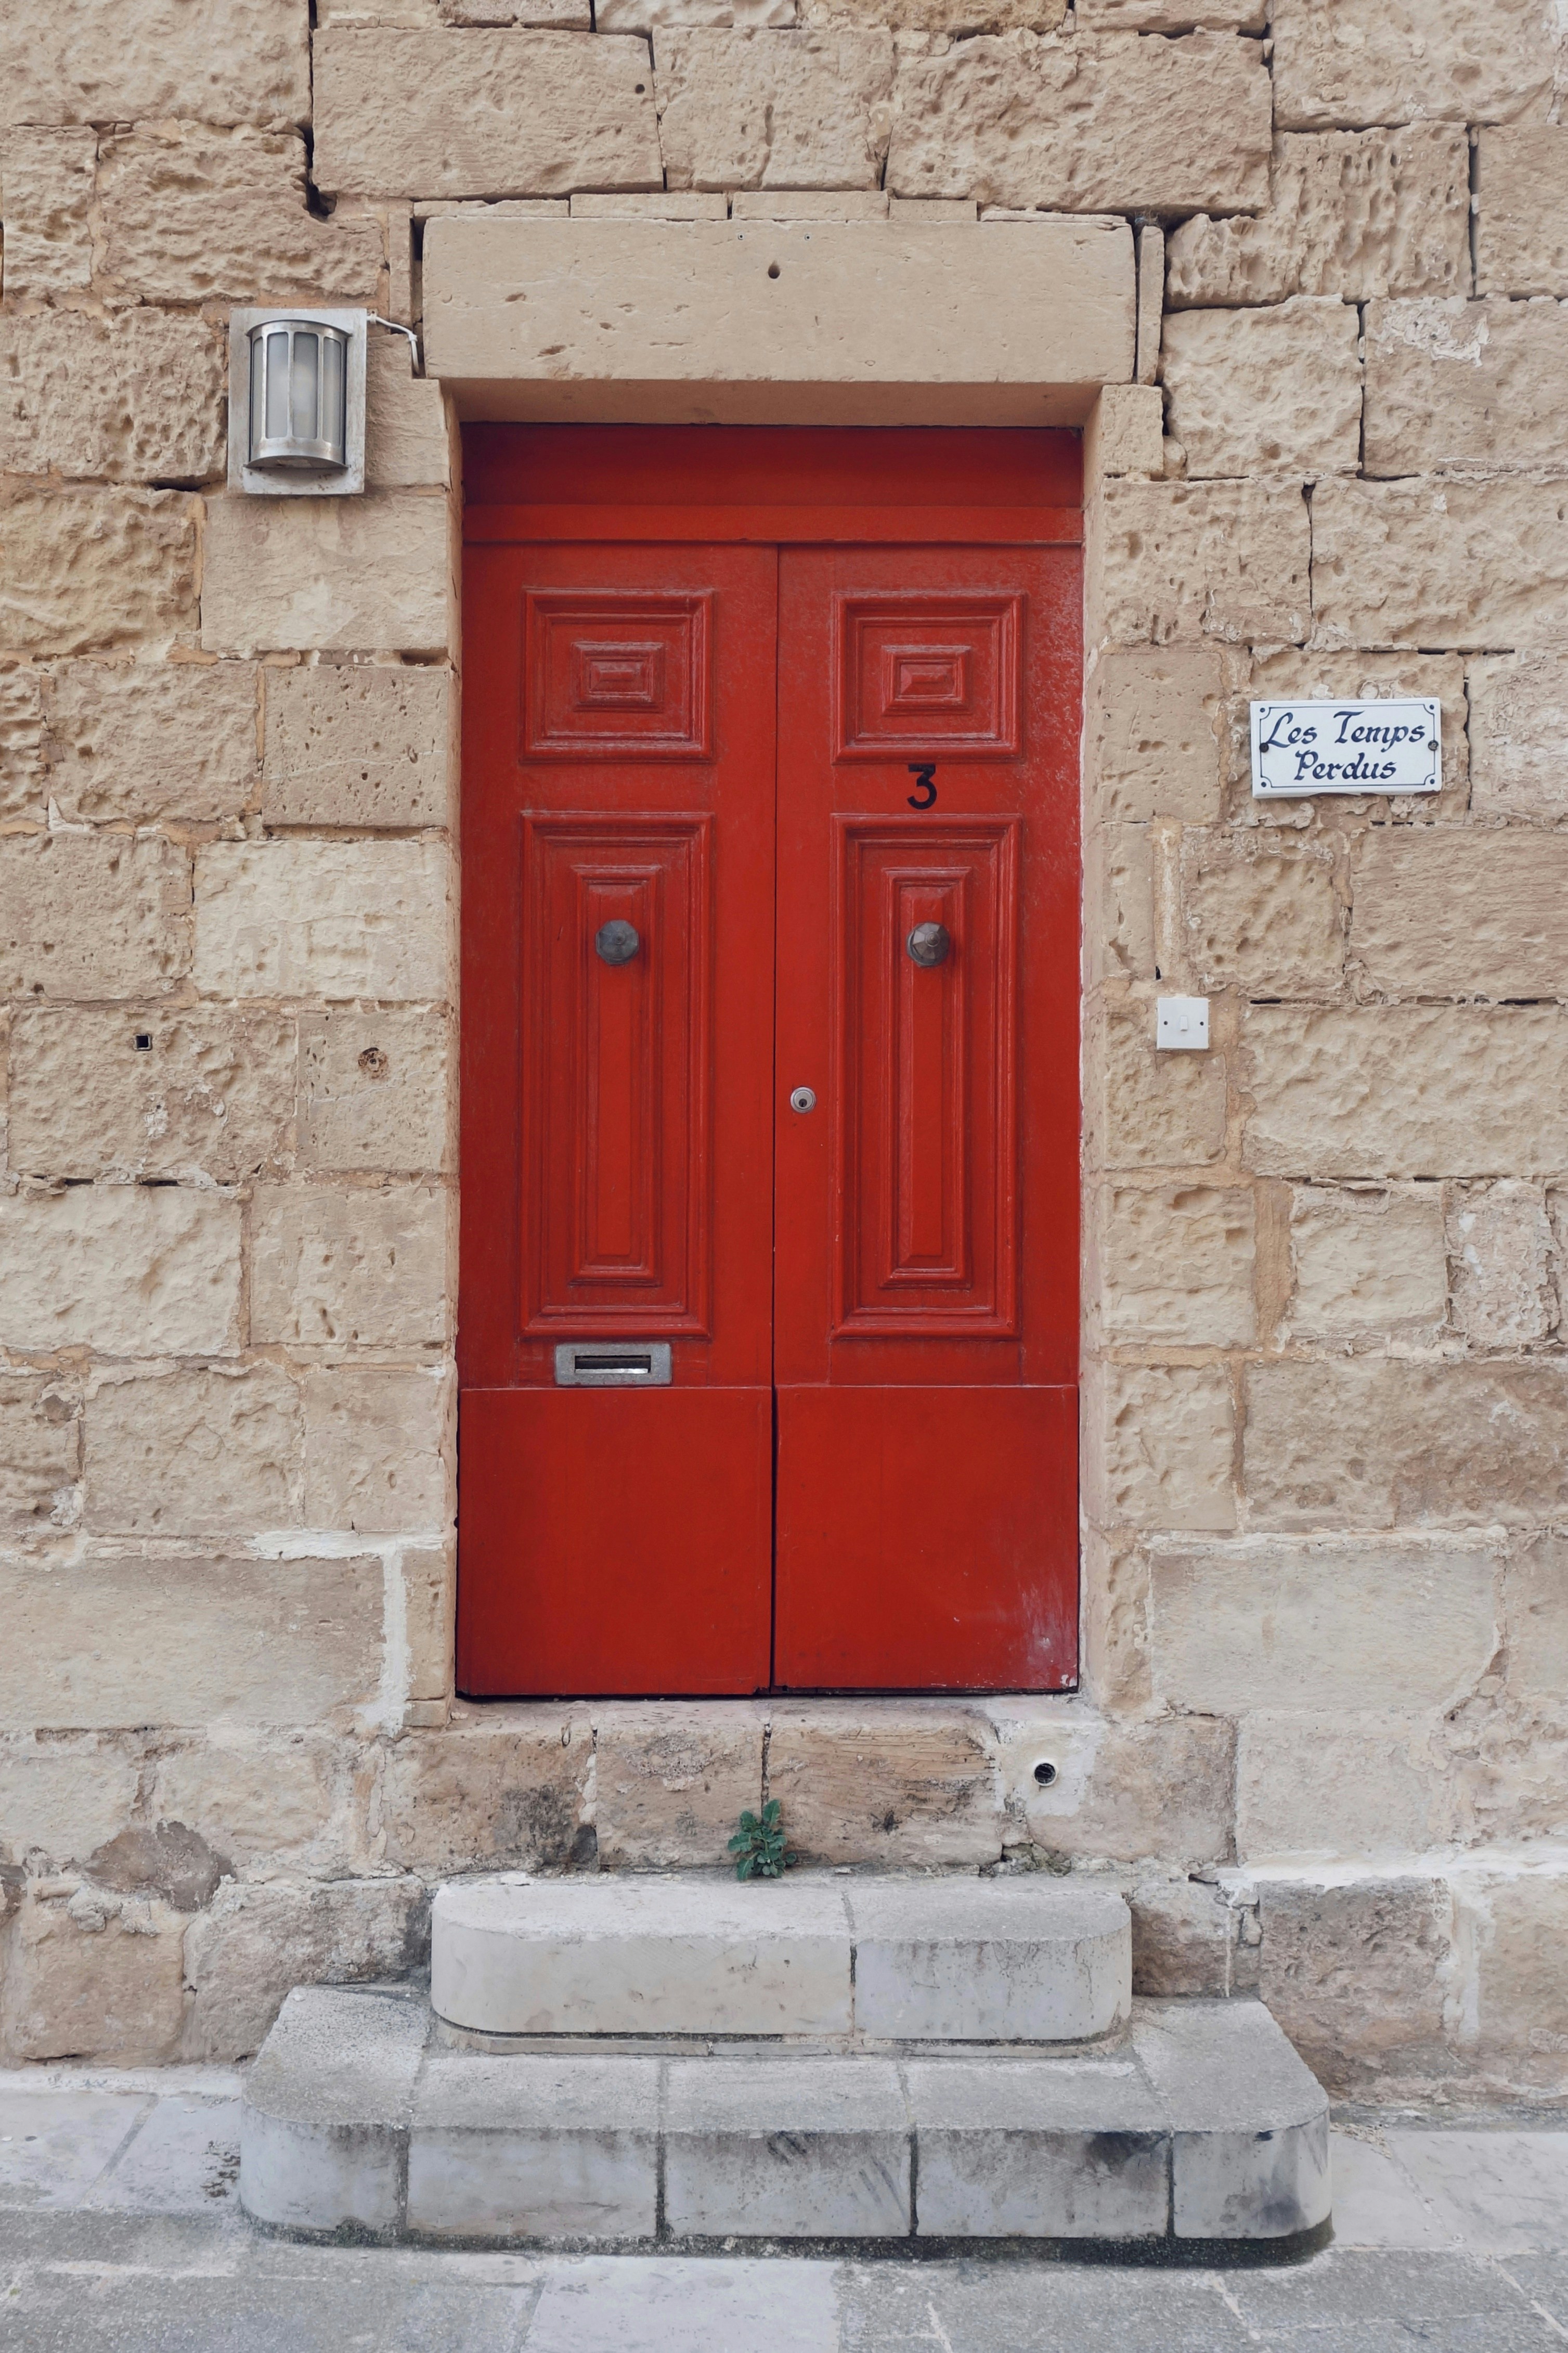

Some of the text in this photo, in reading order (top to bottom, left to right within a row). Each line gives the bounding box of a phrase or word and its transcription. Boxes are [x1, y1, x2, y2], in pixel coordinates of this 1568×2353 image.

[1267, 710, 1426, 752] Les Temps
[1293, 749, 1397, 781] Perdus
[907, 763, 938, 810] 3
